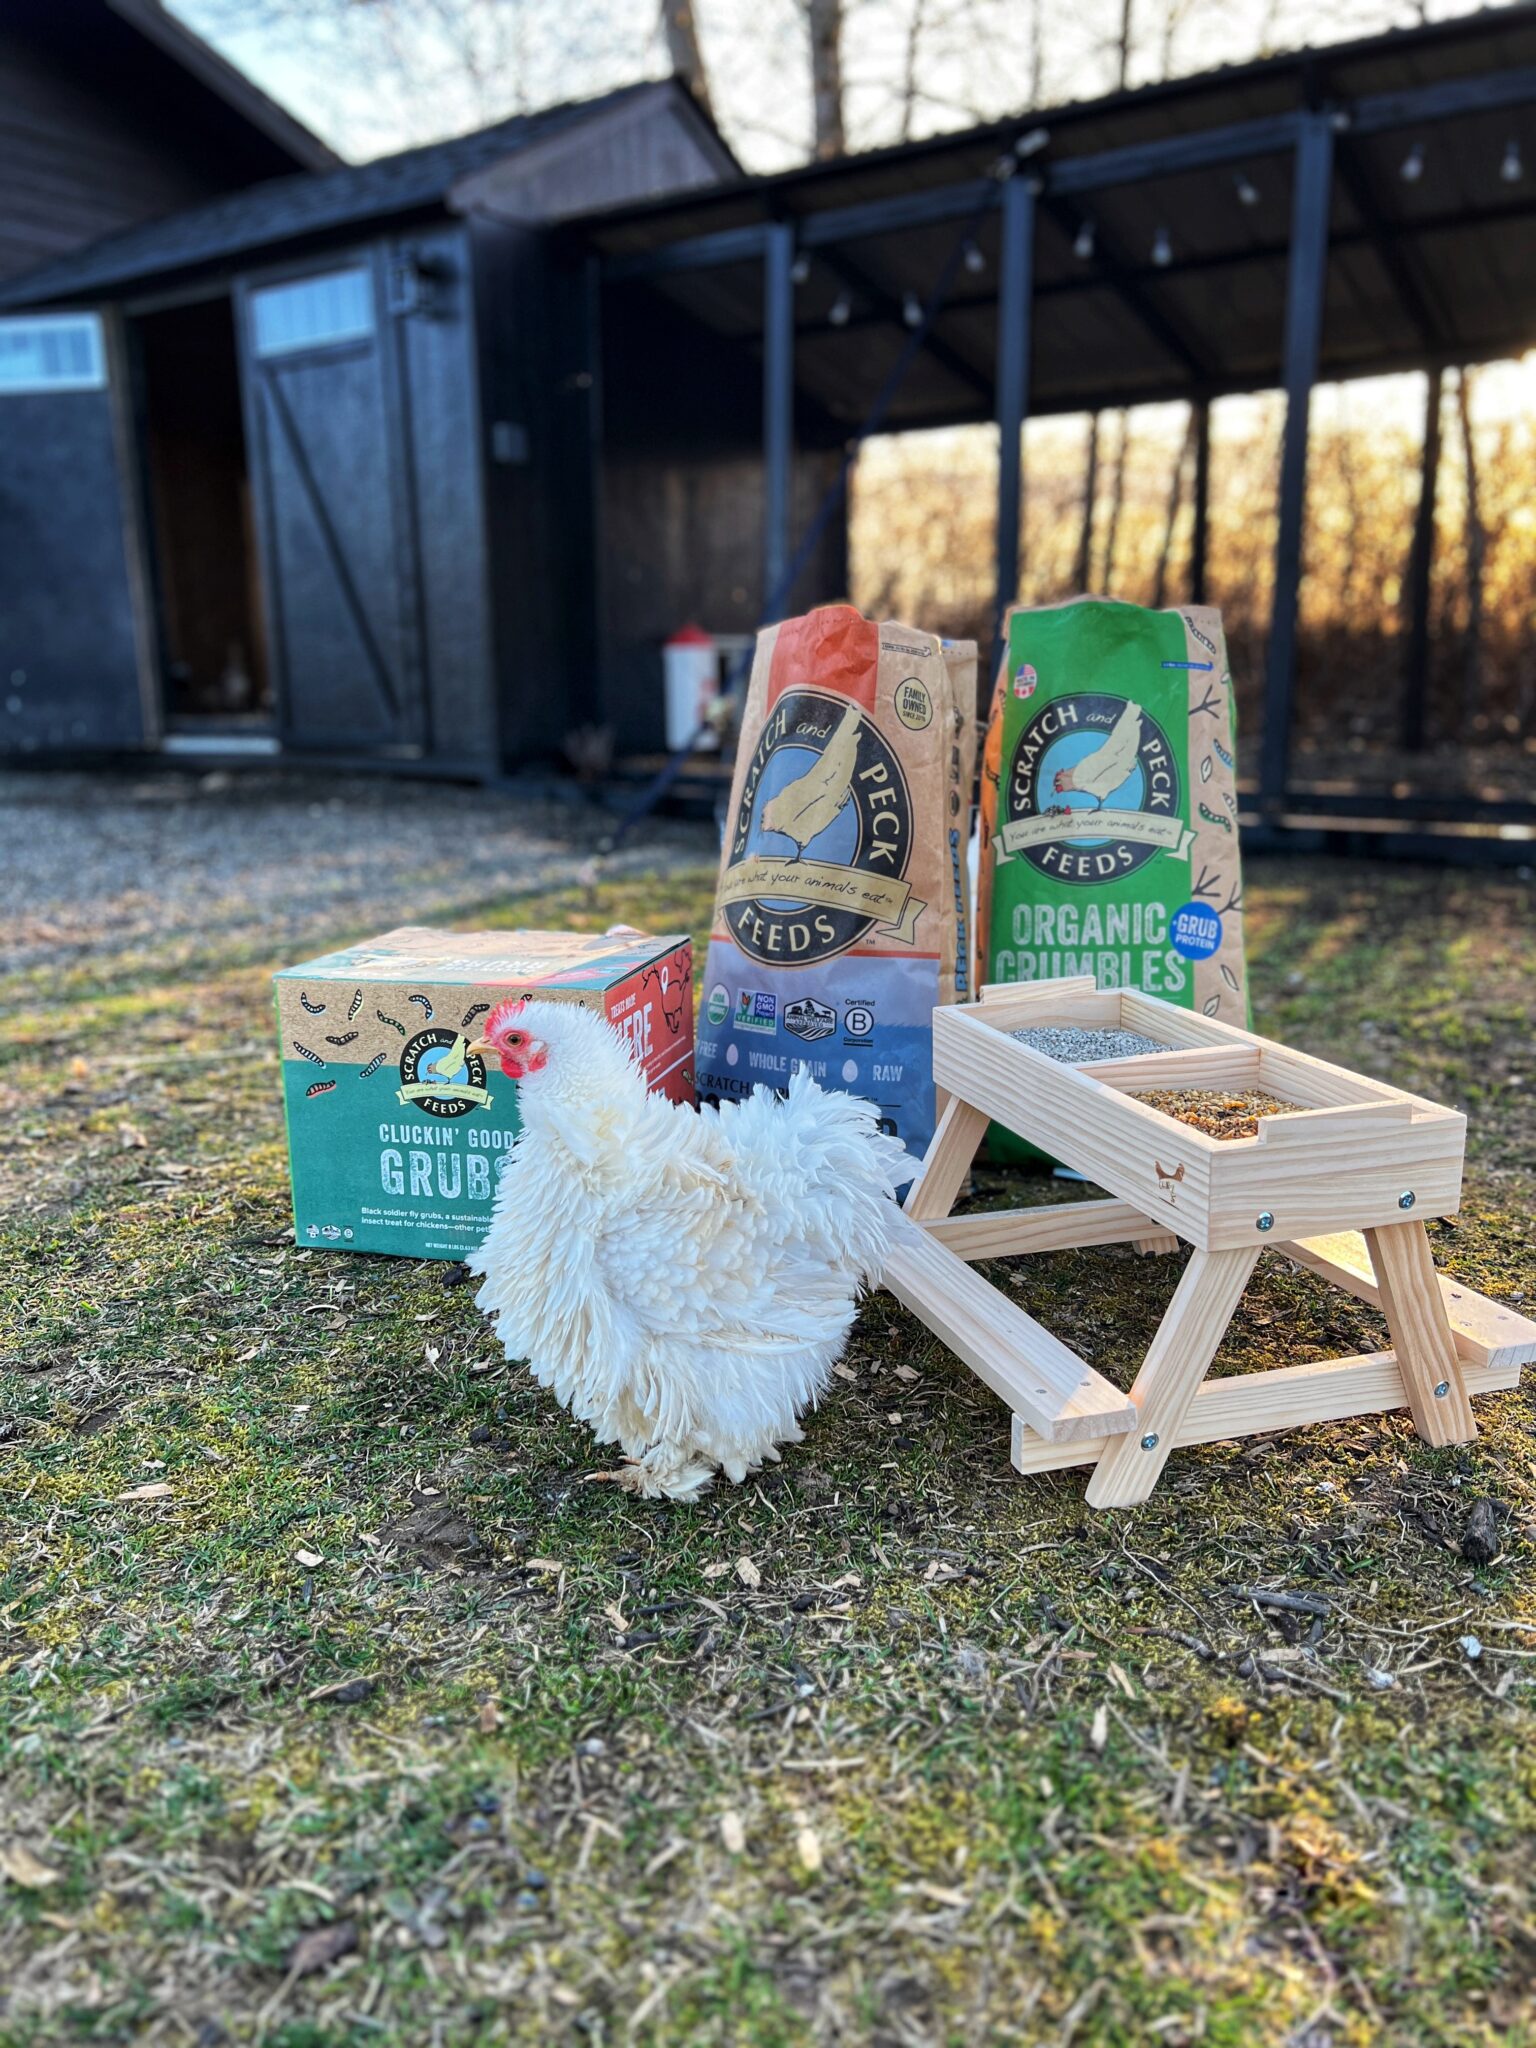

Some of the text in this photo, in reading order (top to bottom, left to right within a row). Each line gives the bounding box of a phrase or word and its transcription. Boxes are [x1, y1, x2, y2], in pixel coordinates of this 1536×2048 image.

[904, 686, 926, 702] FAMILY
[903, 698, 926, 715] OWNED
[1014, 704, 1171, 811] SCRATCH and PECK
[734, 708, 900, 865] SCRATCH and PECK
[1009, 831, 1029, 843] You
[1031, 826, 1046, 836] are
[1049, 818, 1074, 832] what
[1075, 819, 1104, 830] your
[1106, 818, 1145, 832] animals
[1042, 846, 1133, 876] FEEDS
[770, 873, 800, 888] your
[805, 877, 856, 895] animals
[737, 906, 836, 952] FEEDS
[1012, 902, 1167, 946] ORGANIC
[1175, 933, 1215, 950] PROTEIN
[996, 949, 1186, 992] CRUMBLES
[756, 1002, 775, 1012] GMO
[757, 994, 775, 1004] NON
[845, 998, 875, 1006] Certified
[736, 1013, 775, 1027] VERIFIED
[852, 1013, 866, 1030] B
[404, 1033, 482, 1085] SCRATCH and PECK
[749, 1050, 827, 1078] WHOLE GAIN
[872, 1064, 903, 1082] RAW
[423, 1098, 466, 1113] FEEDS
[468, 1128, 514, 1149] GOOD
[361, 1206, 382, 1216] Black
[383, 1208, 408, 1217] soldier
[409, 1211, 418, 1219] fly
[420, 1211, 444, 1220] grubs,
[361, 1216, 384, 1225] insect
[385, 1217, 403, 1227] treat
[404, 1219, 415, 1227] for
